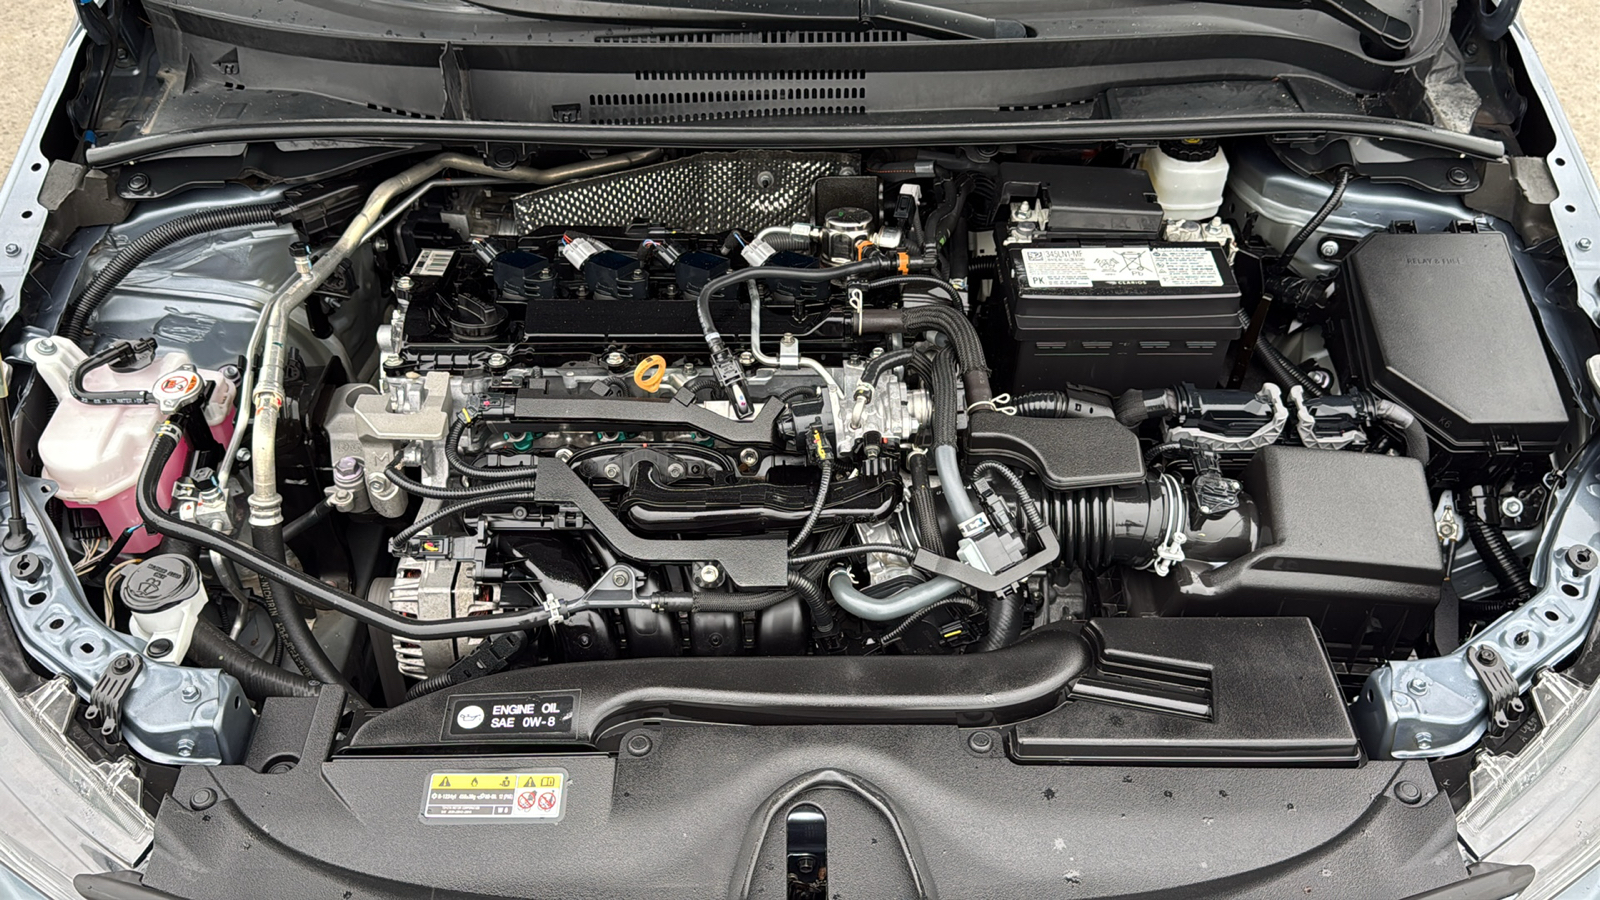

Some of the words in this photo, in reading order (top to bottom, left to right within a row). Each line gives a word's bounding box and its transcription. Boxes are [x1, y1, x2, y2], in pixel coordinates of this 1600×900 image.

[1032, 276, 1045, 284] PK
[1438, 416, 1452, 429] K6
[492, 704, 535, 715] ENGINE
[541, 703, 560, 714] OIL
[491, 717, 515, 728] SAE
[522, 716, 556, 728] 0W-8
